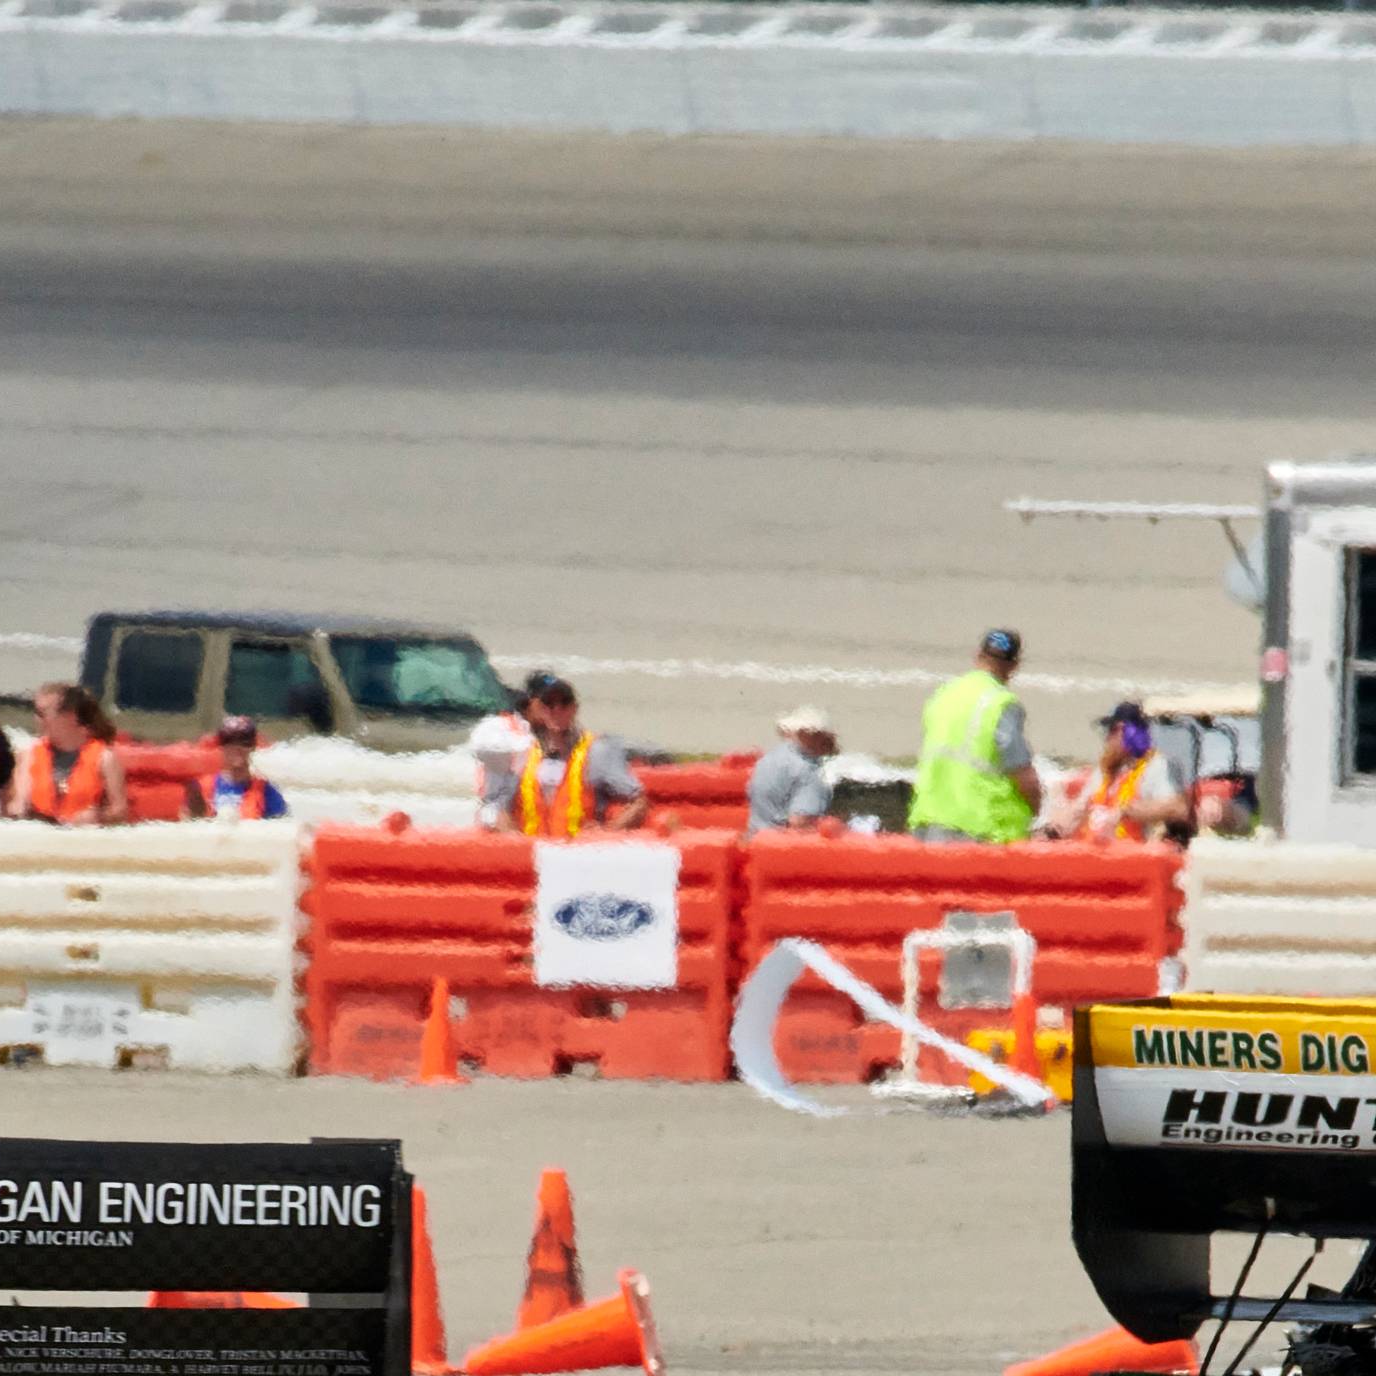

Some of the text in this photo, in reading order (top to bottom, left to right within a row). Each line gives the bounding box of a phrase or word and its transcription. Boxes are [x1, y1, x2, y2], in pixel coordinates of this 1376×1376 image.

[1133, 1027, 1284, 1070] MINERS
[1301, 1033, 1370, 1074] DIG
[1161, 1122, 1361, 1149] Engineering
[98, 1181, 381, 1228] ENGINEERING
[25, 1229, 134, 1247] MICHIGAN
[52, 1326, 127, 1344] Thanks
